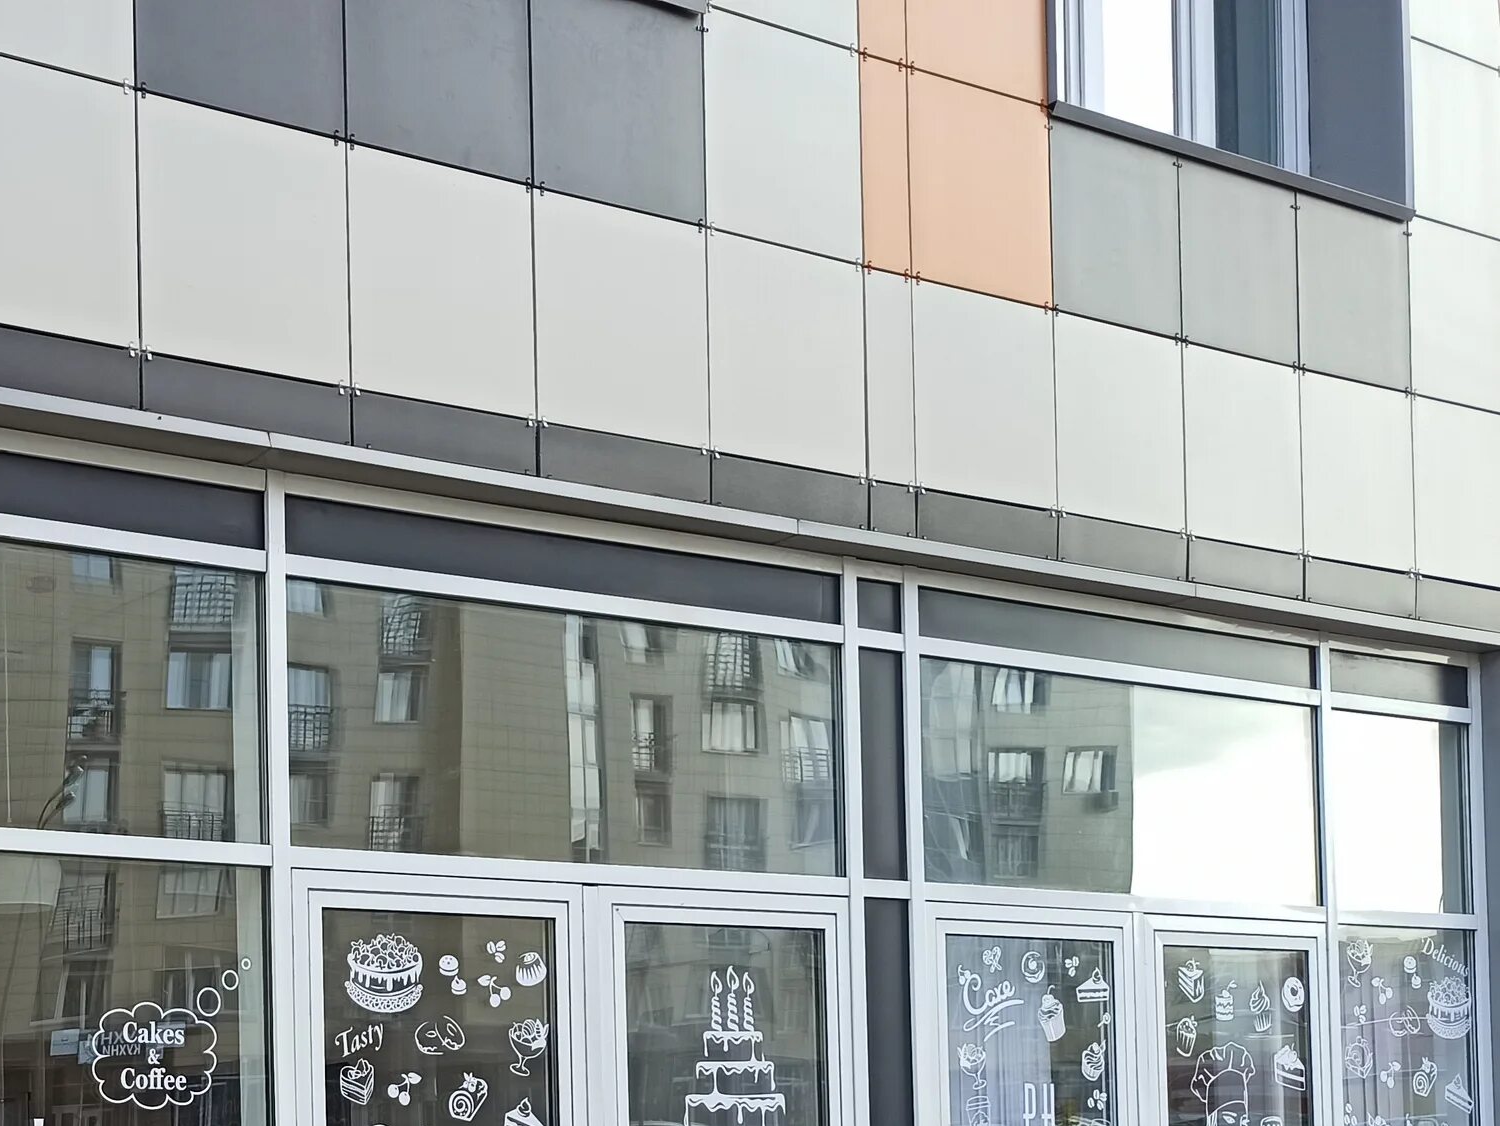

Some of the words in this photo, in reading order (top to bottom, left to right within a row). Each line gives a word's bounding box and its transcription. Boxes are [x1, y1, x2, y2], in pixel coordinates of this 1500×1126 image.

[1422, 937, 1469, 976] Delicious
[122, 1021, 185, 1045] Cakes
[335, 1022, 384, 1058] Tasty
[147, 1048, 160, 1065] &
[120, 1067, 187, 1091] Coffee
